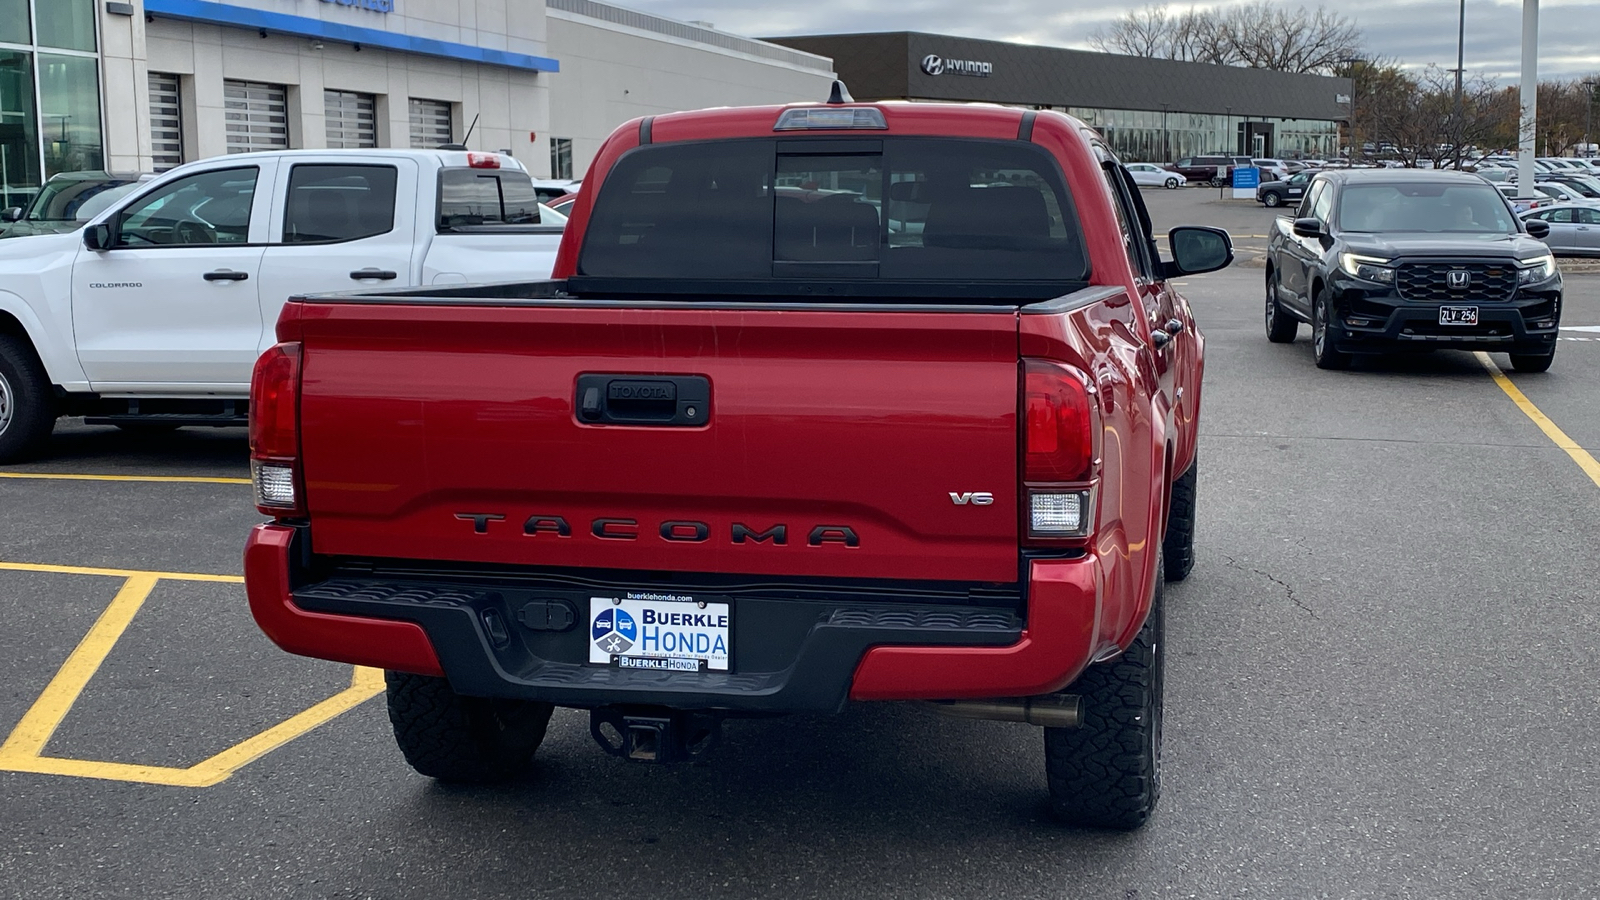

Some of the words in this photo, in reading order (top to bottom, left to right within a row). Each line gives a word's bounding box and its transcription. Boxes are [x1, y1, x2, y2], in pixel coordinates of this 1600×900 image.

[1442, 310, 1457, 321] ZLV
[1461, 310, 1476, 321] 256
[612, 385, 670, 399] TOYOTA
[948, 491, 994, 506] V6
[453, 512, 861, 549] TACOMA
[627, 592, 693, 602] buerklehonda.com
[642, 609, 728, 628] BUERKLE
[642, 626, 727, 655] HONDA
[621, 657, 668, 668] BUERKLE
[669, 659, 697, 670] HONDA
